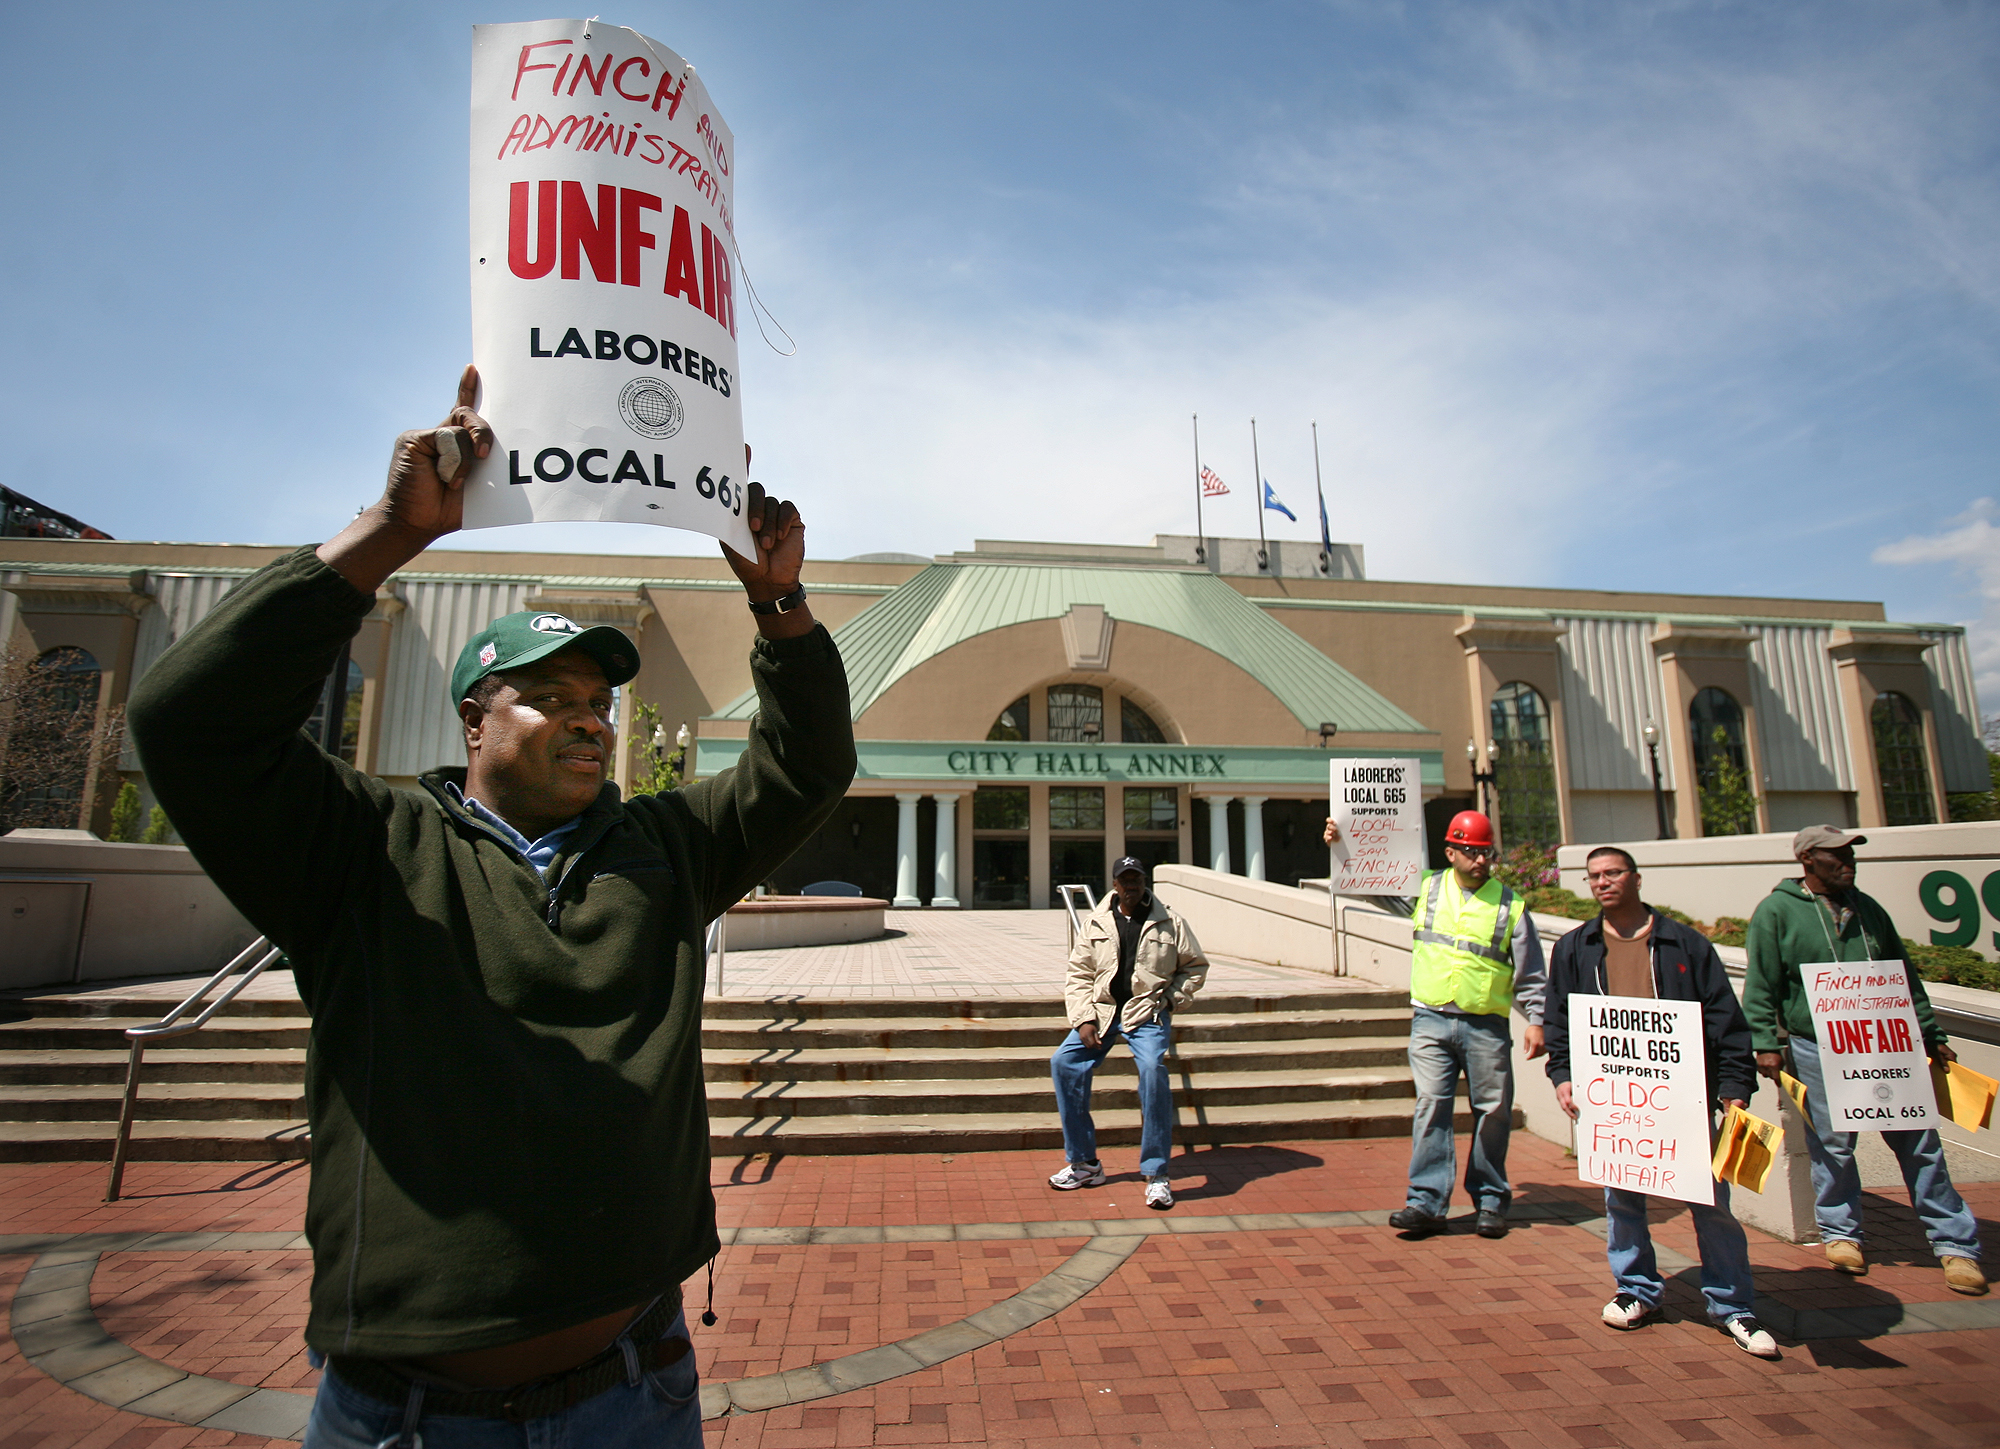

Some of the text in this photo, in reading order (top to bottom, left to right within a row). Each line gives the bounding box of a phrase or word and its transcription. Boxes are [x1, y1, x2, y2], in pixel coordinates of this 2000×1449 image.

[511, 39, 729, 177] FINCH AND
[508, 180, 736, 343] UNFAIR
[530, 327, 733, 398] LABORERS'
[509, 447, 742, 517] LOCAL 665
[947, 750, 1226, 775] CITY HALL ANNEX
[1344, 767, 1405, 784] LABORERS'
[1344, 787, 1406, 804] LOCAL 665
[1351, 807, 1399, 816] SUPPORTS
[1350, 818, 1404, 833] LOCAL
[1341, 858, 1400, 874] FINCH
[1865, 975, 1888, 987] AND
[1589, 1006, 1678, 1034] LABORERS'
[1827, 1018, 1914, 1055] UNFAIR
[1590, 1034, 1681, 1064] LOCAL 665
[1601, 1063, 1670, 1080] SUPPORTS
[1842, 1067, 1911, 1080] LABORERS'
[1587, 1078, 1670, 1111] CLDC
[1844, 1105, 1926, 1120] LOCAL 665
